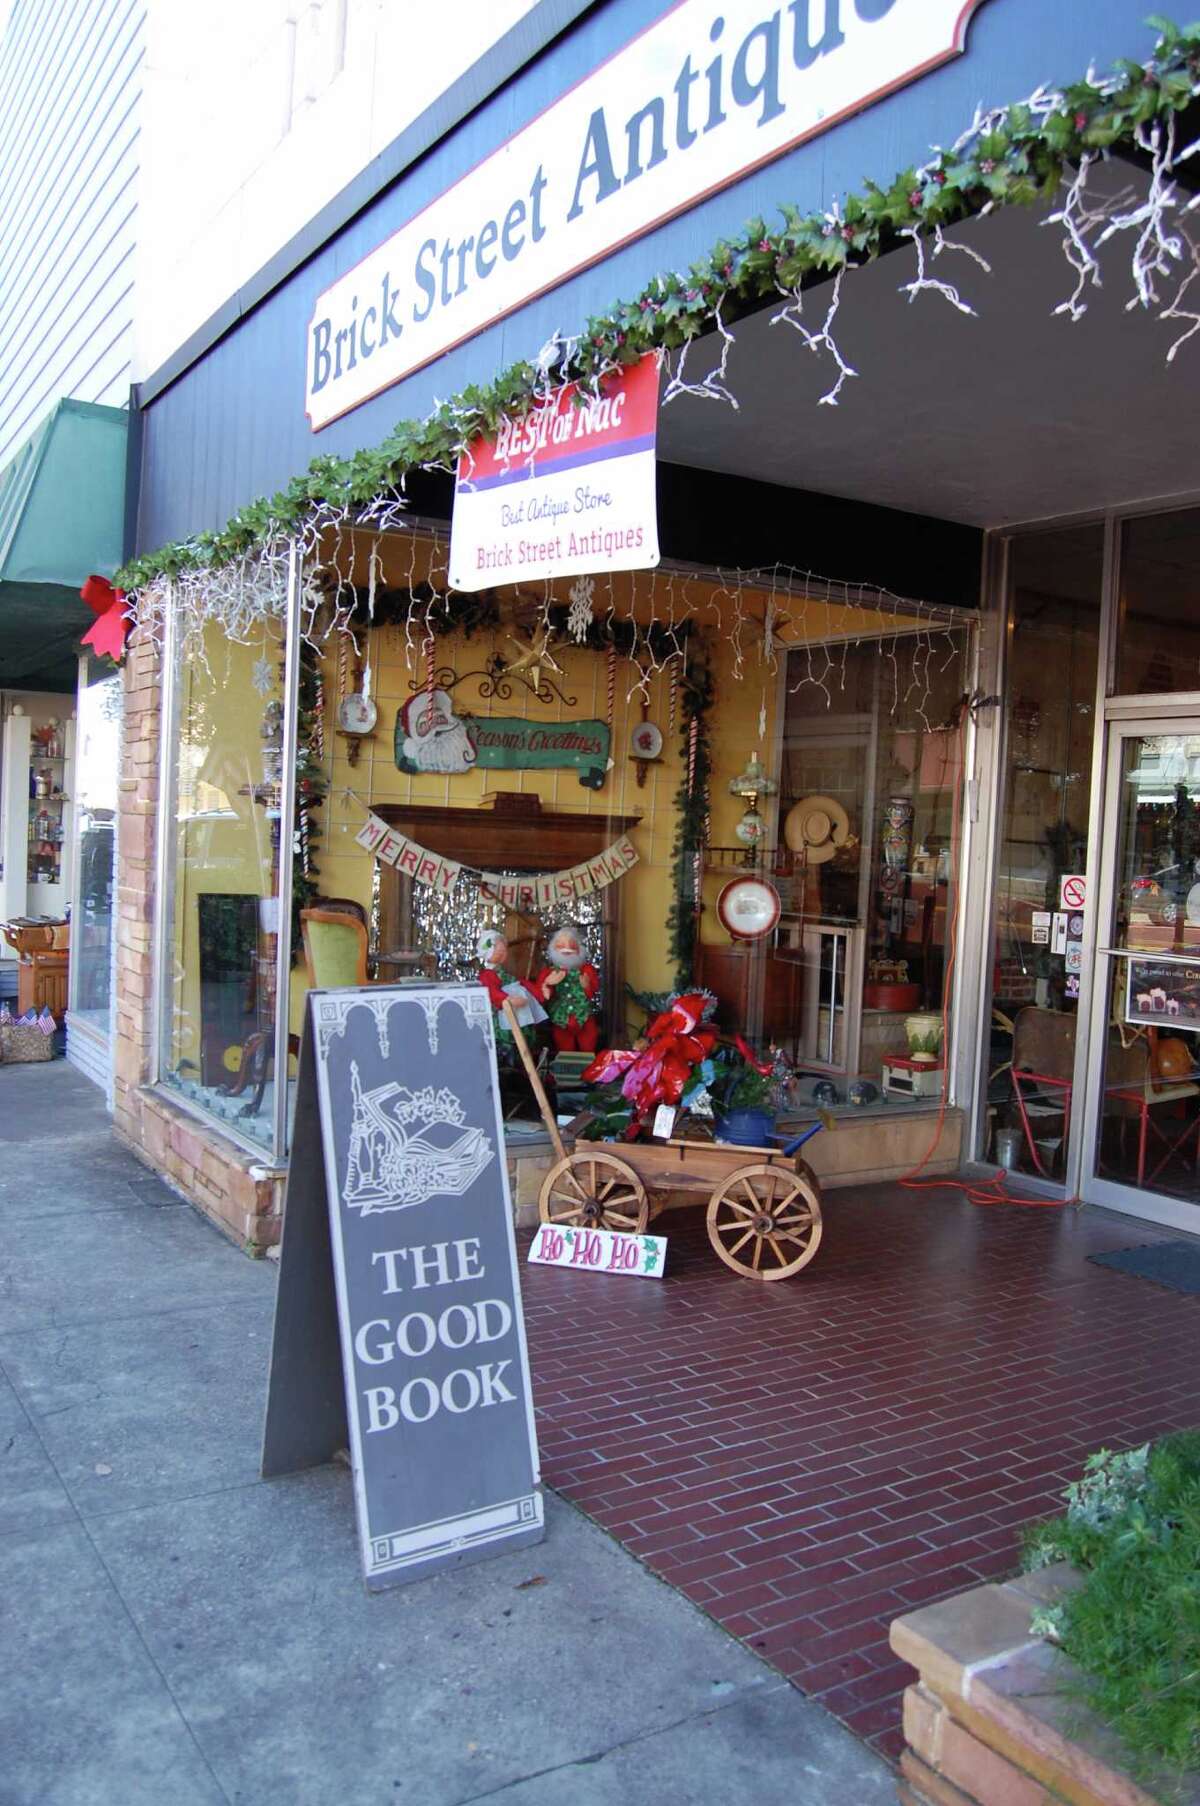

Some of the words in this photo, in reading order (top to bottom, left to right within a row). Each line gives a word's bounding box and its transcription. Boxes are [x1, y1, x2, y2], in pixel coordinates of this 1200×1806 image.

[311, 271, 403, 395] Brick
[413, 164, 547, 322] Street
[567, 0, 897, 223] Antiqu
[493, 404, 559, 461] BEST
[501, 503, 524, 527] Best
[527, 494, 569, 526] Antique
[573, 485, 612, 513] Store
[476, 541, 513, 570] Brick
[518, 536, 561, 564] Street
[568, 525, 644, 558] Antiques
[359, 823, 456, 889] MERRY
[480, 842, 637, 904] CHRISTMAS
[371, 1237, 486, 1295] THE
[355, 1299, 513, 1365] GOOD
[363, 1359, 518, 1434] BOOK
